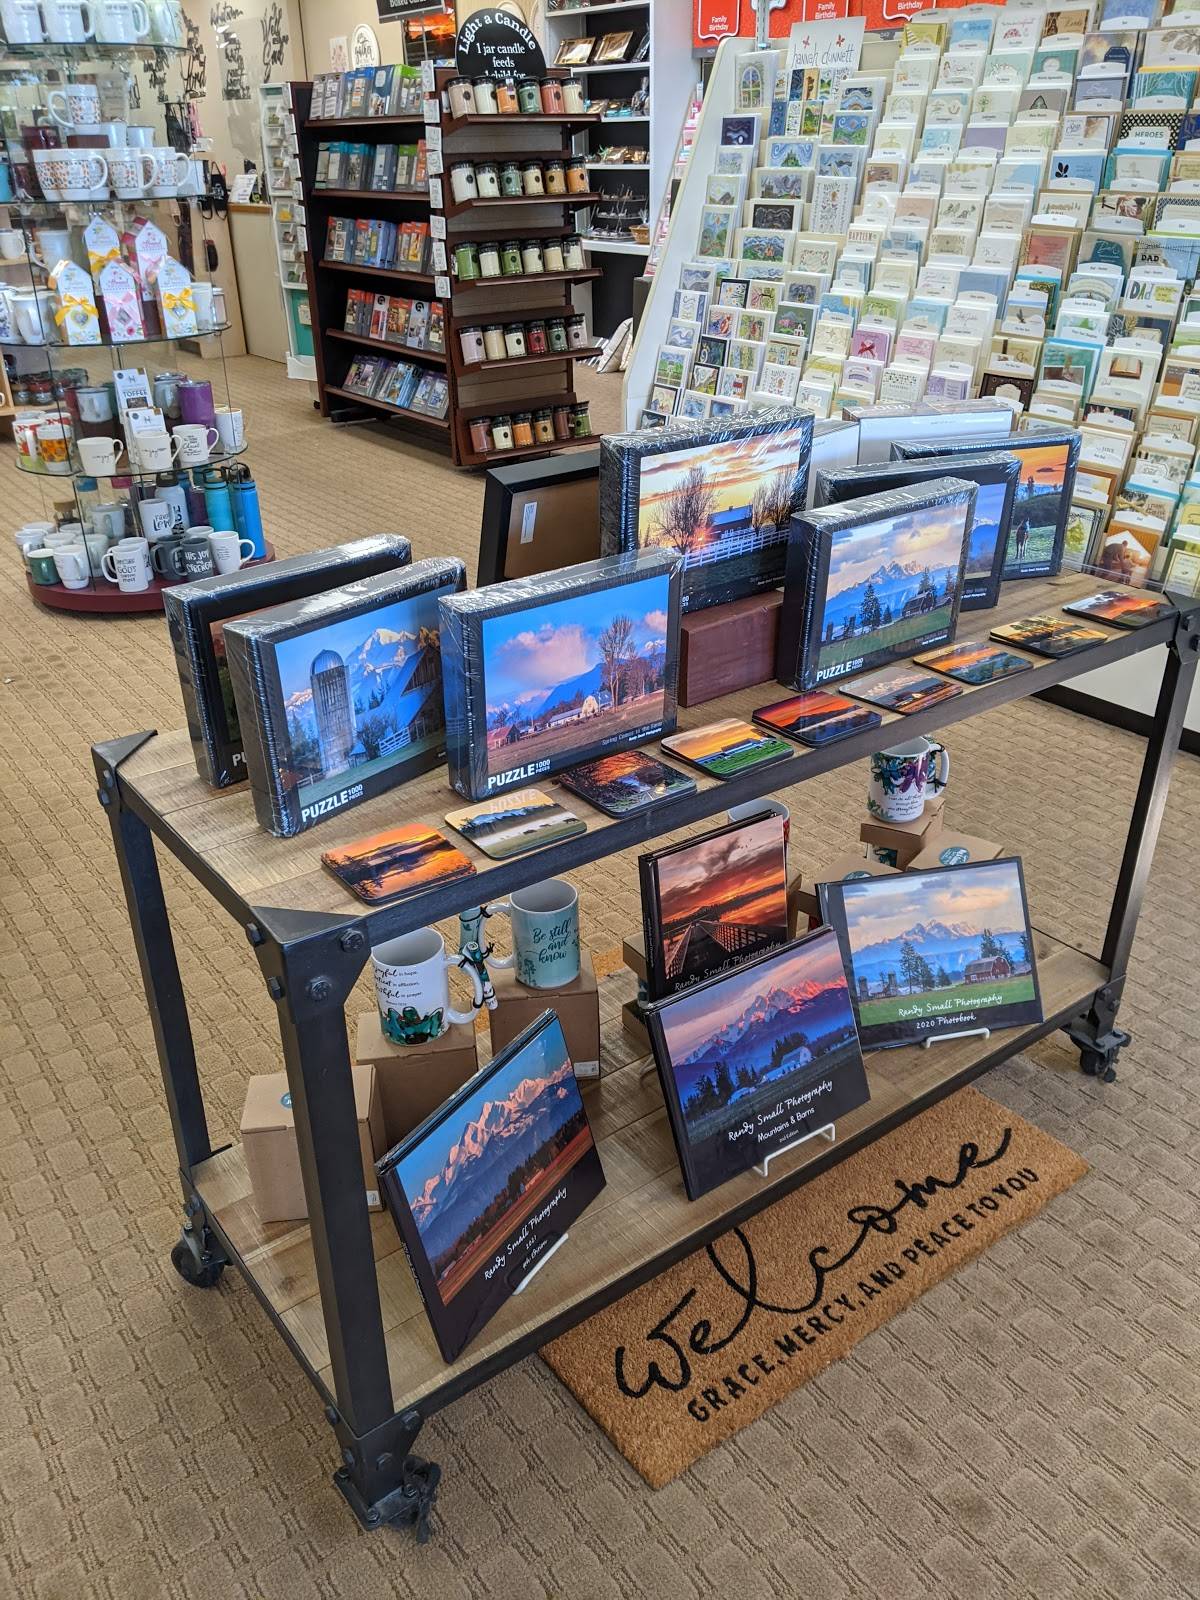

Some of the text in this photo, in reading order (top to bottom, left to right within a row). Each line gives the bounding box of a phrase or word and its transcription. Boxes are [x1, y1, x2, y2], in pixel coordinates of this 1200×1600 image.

[814, 11, 836, 19] Birthday
[818, 2, 836, 12] Family
[897, 1, 923, 10] Birthday
[708, 23, 729, 32] Birthday
[711, 16, 728, 24] Family
[458, 12, 536, 54] Light a Candle
[476, 42, 526, 56] 1 jar candle
[792, 42, 856, 67] hannah dunnett
[492, 56, 515, 68] feeds
[1141, 254, 1160, 262] DAD
[123, 390, 148, 398] TOFFEE
[816, 658, 864, 682] PUZZLE 1000
[488, 759, 550, 789] PUZZLE 1000
[302, 784, 363, 822] PUZZLE 1000
[533, 918, 572, 944] Be still
[547, 936, 570, 952] and
[538, 946, 568, 966] know
[675, 942, 781, 991] Randy Small Photography
[898, 994, 1003, 1017] Randy Small Photography
[916, 1012, 977, 1029] 2020 Photobook
[728, 1080, 833, 1142] Randy Small Photography
[758, 1106, 815, 1143] Mountains & Barns
[484, 1187, 567, 1280] Randy Small Photography
[614, 1128, 1012, 1400] Welcome
[688, 1166, 1040, 1423] GRACE, MERCY, AND PEACE TO YOU
